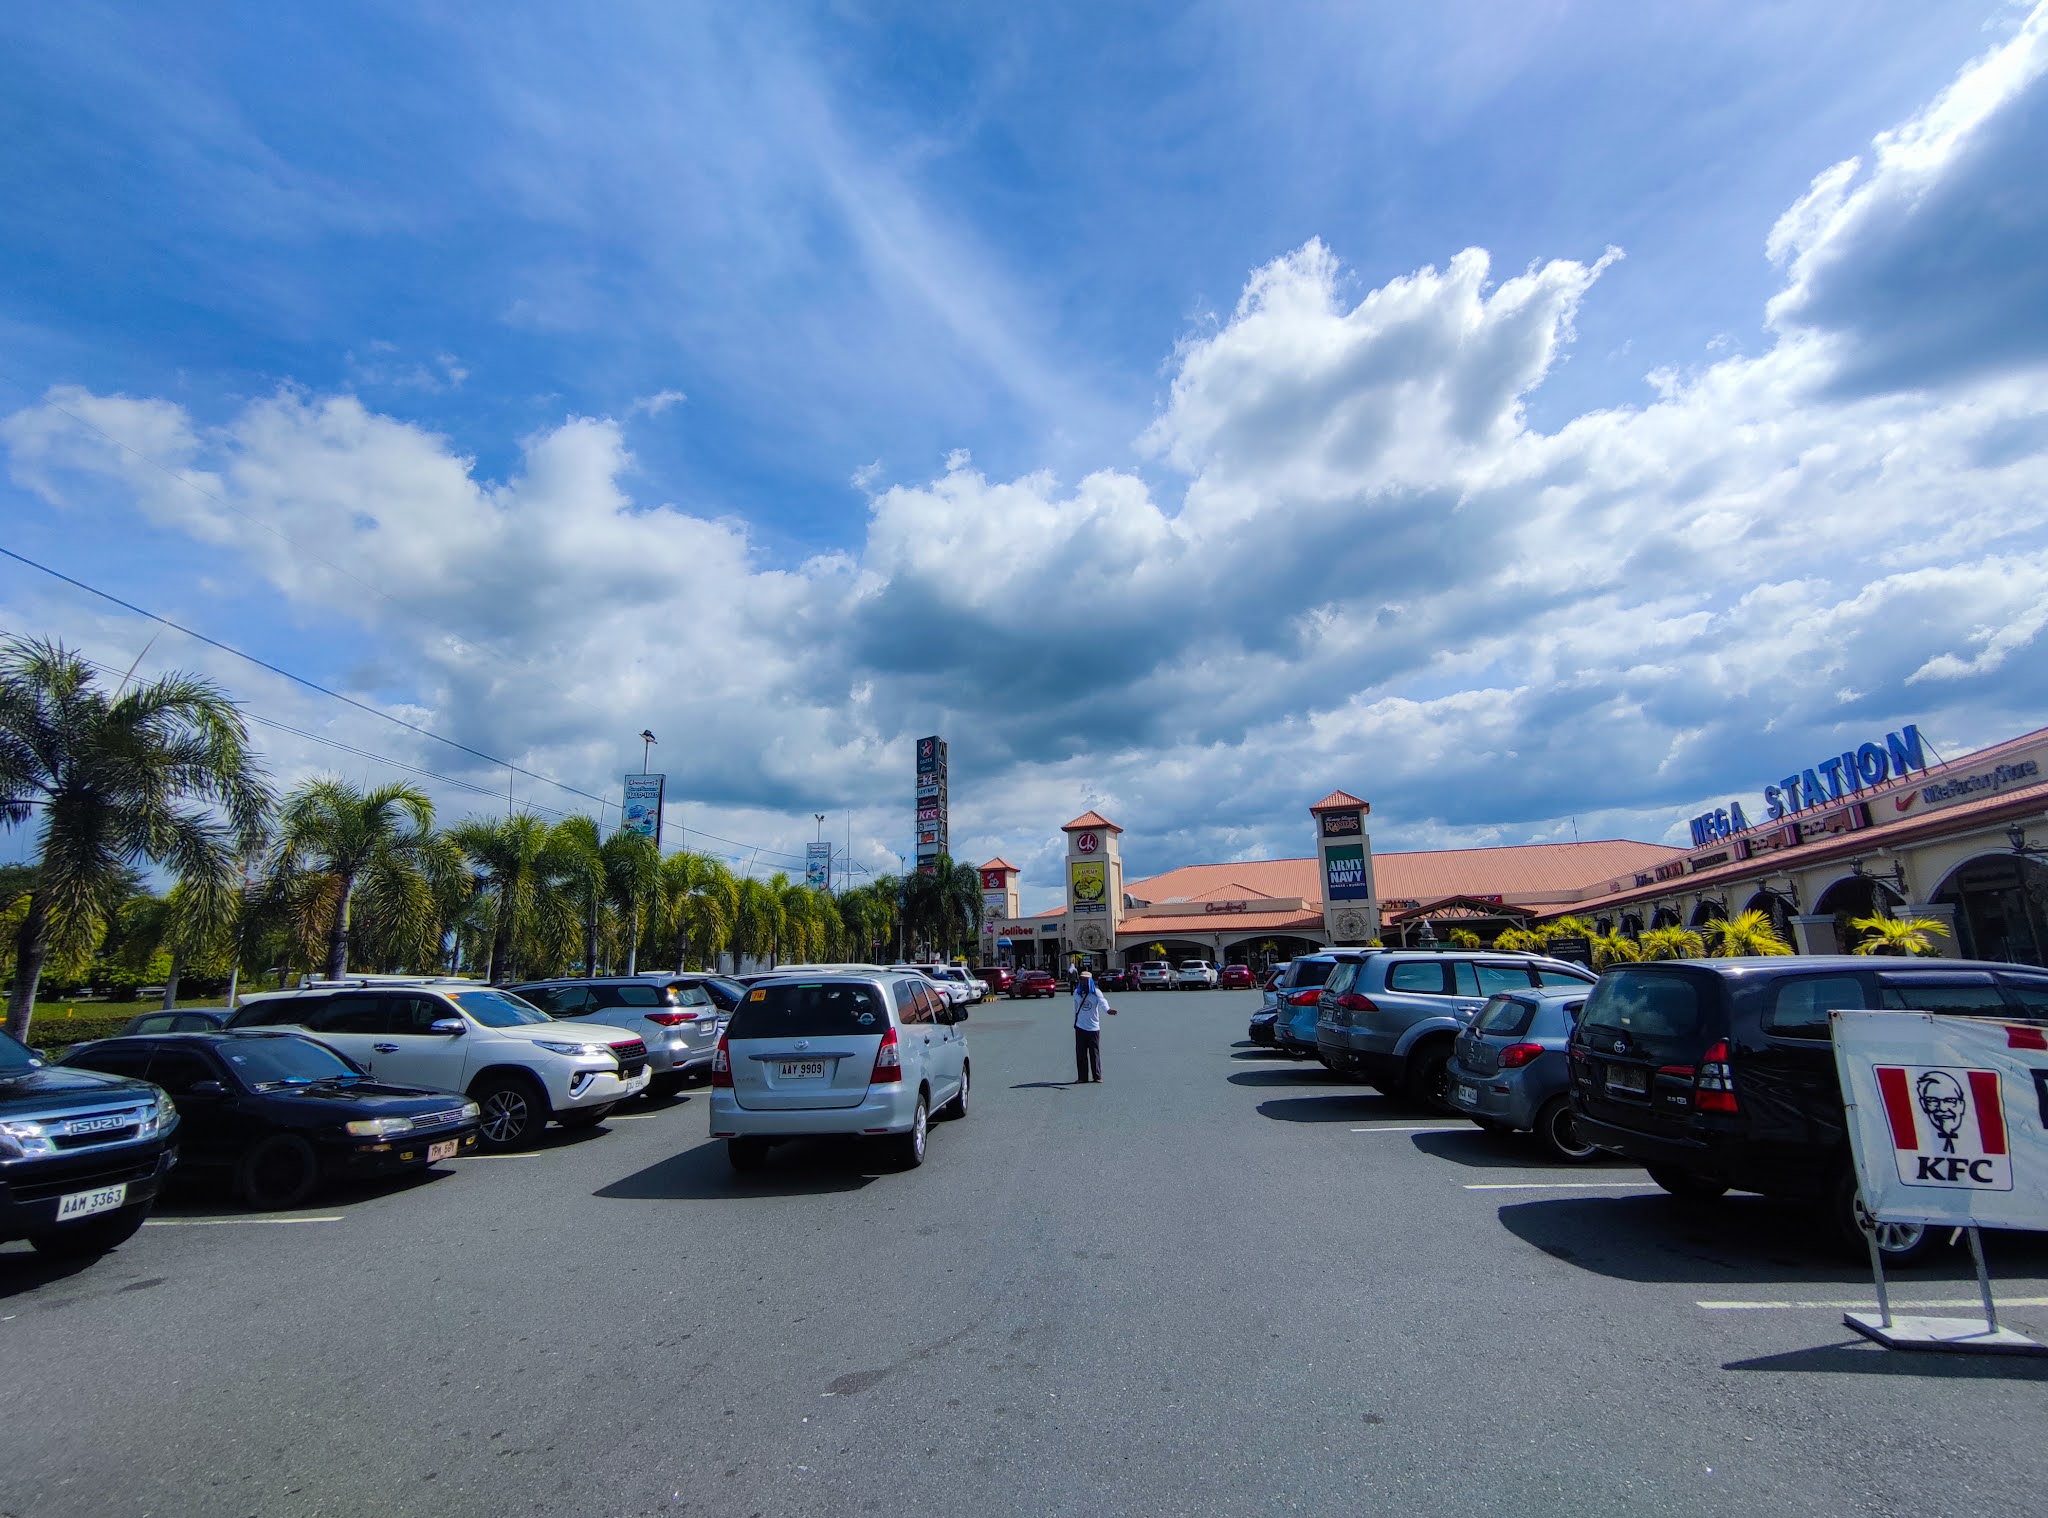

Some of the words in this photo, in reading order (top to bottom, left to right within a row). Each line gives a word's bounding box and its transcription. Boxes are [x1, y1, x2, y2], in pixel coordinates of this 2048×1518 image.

[1690, 801, 1748, 847] MEGA
[1765, 724, 1927, 820] STATION
[919, 809, 937, 820] KFC
[1329, 859, 1362, 871] ARMY
[1330, 871, 1362, 883] NAVY
[1000, 925, 1034, 936] Jollibee
[782, 1065, 798, 1075] AAY
[801, 1063, 822, 1074] 9909
[72, 1116, 123, 1133] ISUZU
[1916, 1156, 1993, 1183] KFC
[62, 1196, 87, 1214] AAM
[91, 1188, 122, 1208] 3363
